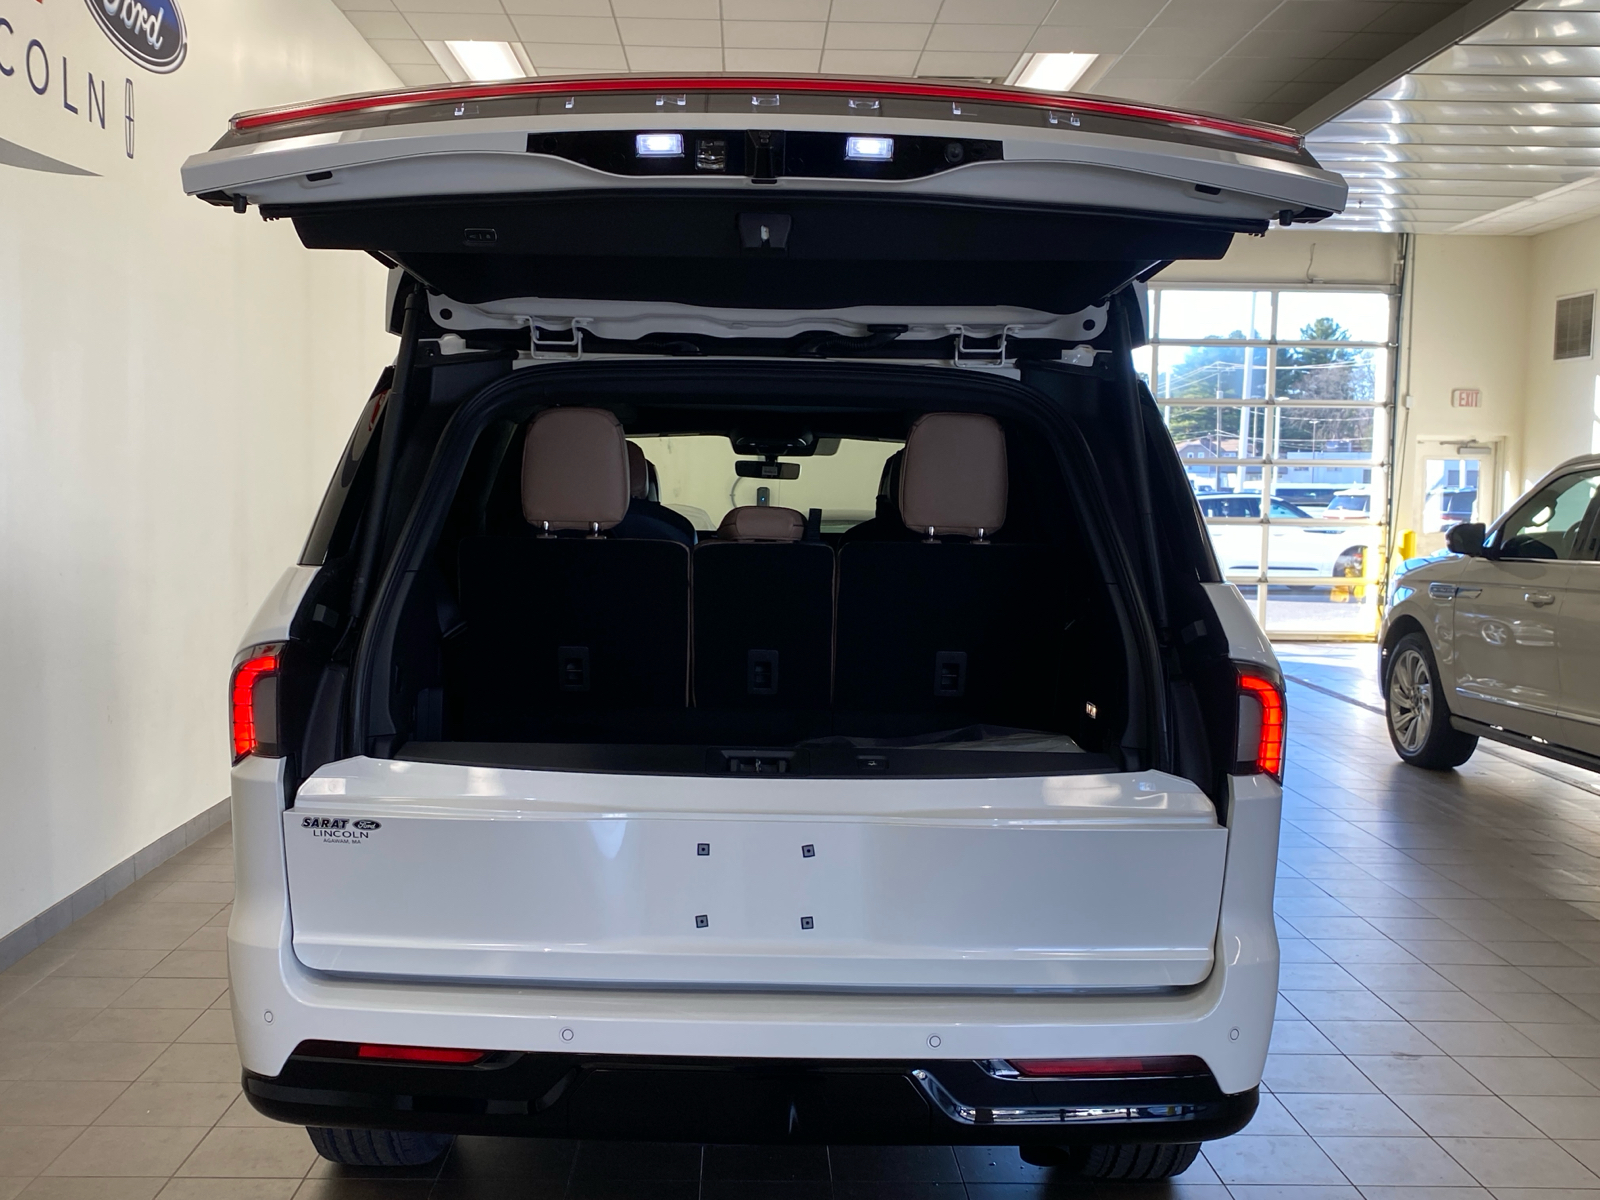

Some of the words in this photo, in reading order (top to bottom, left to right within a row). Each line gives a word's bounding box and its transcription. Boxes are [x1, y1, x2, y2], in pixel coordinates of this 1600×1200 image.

[1458, 390, 1480, 408] EXIT
[301, 817, 350, 830] SARAT
[356, 820, 379, 830] Ford
[313, 829, 369, 839] LINCOLN
